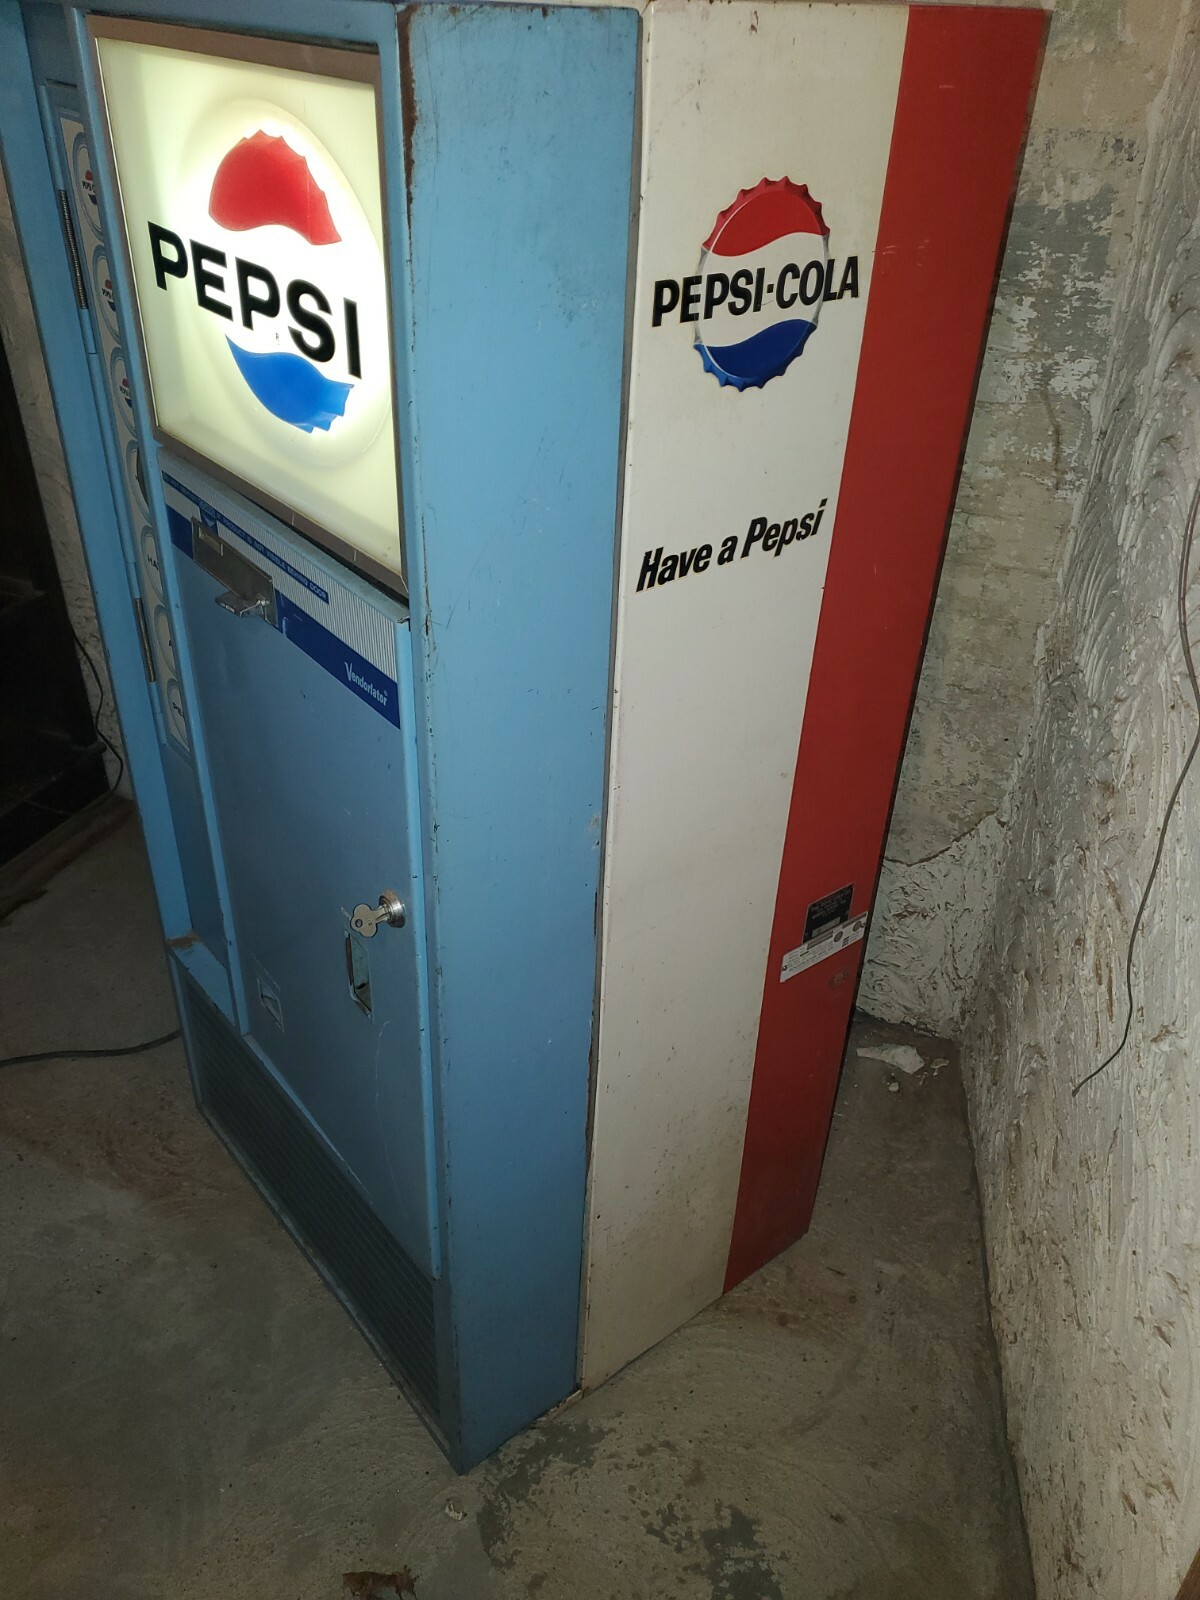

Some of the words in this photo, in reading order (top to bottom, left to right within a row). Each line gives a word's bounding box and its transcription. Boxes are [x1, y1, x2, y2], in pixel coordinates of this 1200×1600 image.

[147, 221, 362, 380] PEPSI
[636, 544, 712, 592] Have
[717, 534, 739, 566] a
[740, 498, 828, 559] Pepsi
[310, 581, 327, 600] DOOR
[344, 661, 388, 706] Vendorlator
